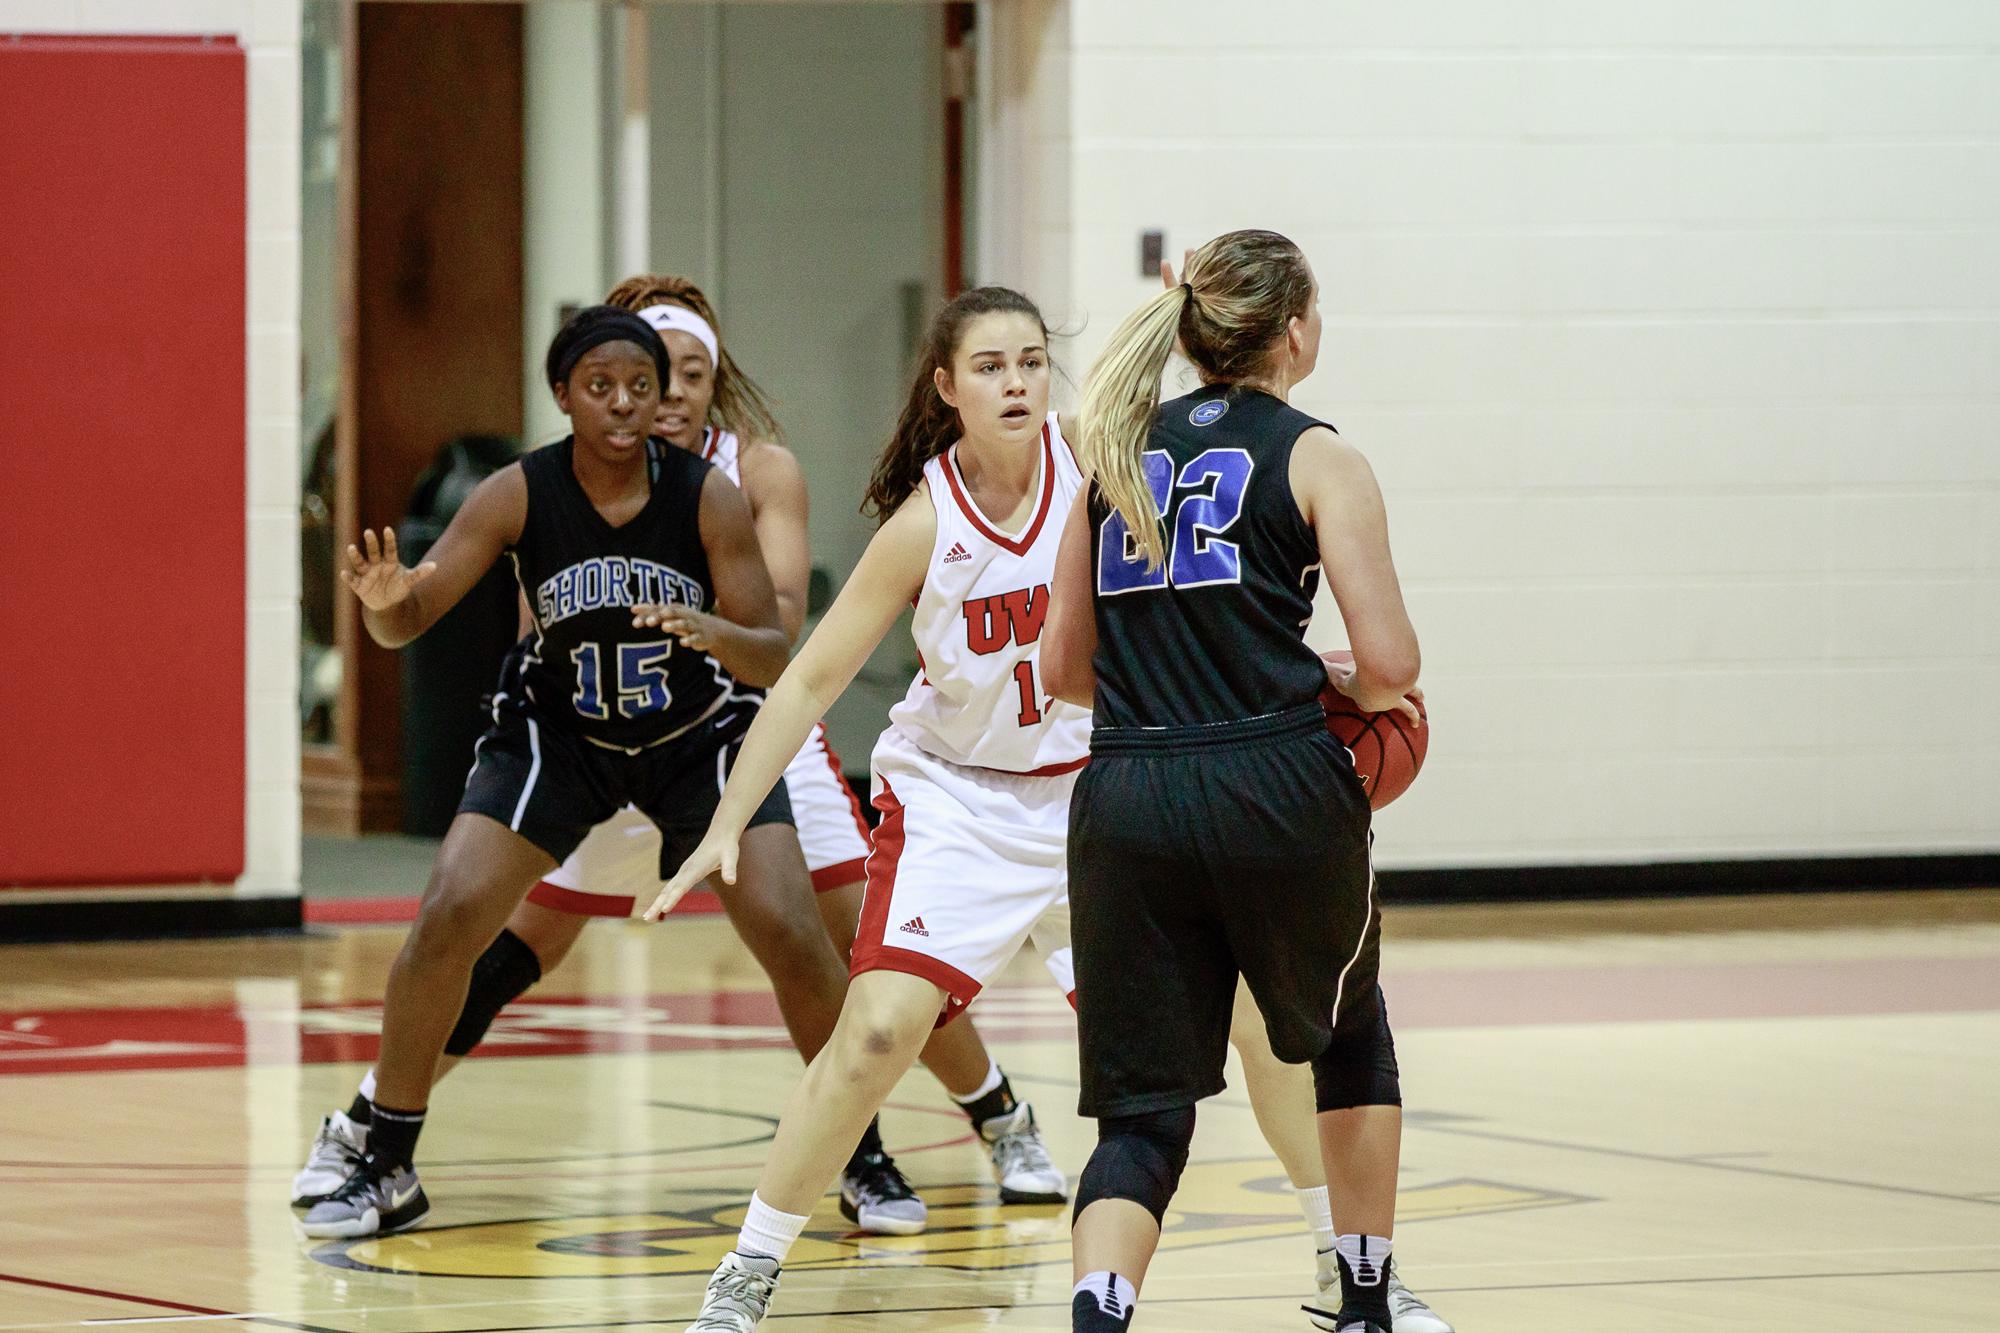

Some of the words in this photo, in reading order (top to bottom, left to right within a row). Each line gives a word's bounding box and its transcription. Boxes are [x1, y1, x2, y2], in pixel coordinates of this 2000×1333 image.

[943, 552, 972, 563] adidas
[1097, 448, 1255, 597] 22
[537, 556, 704, 630] SHORTER
[569, 638, 673, 720] 15
[1013, 660, 1055, 728] 1
[899, 925, 929, 937] adidas
